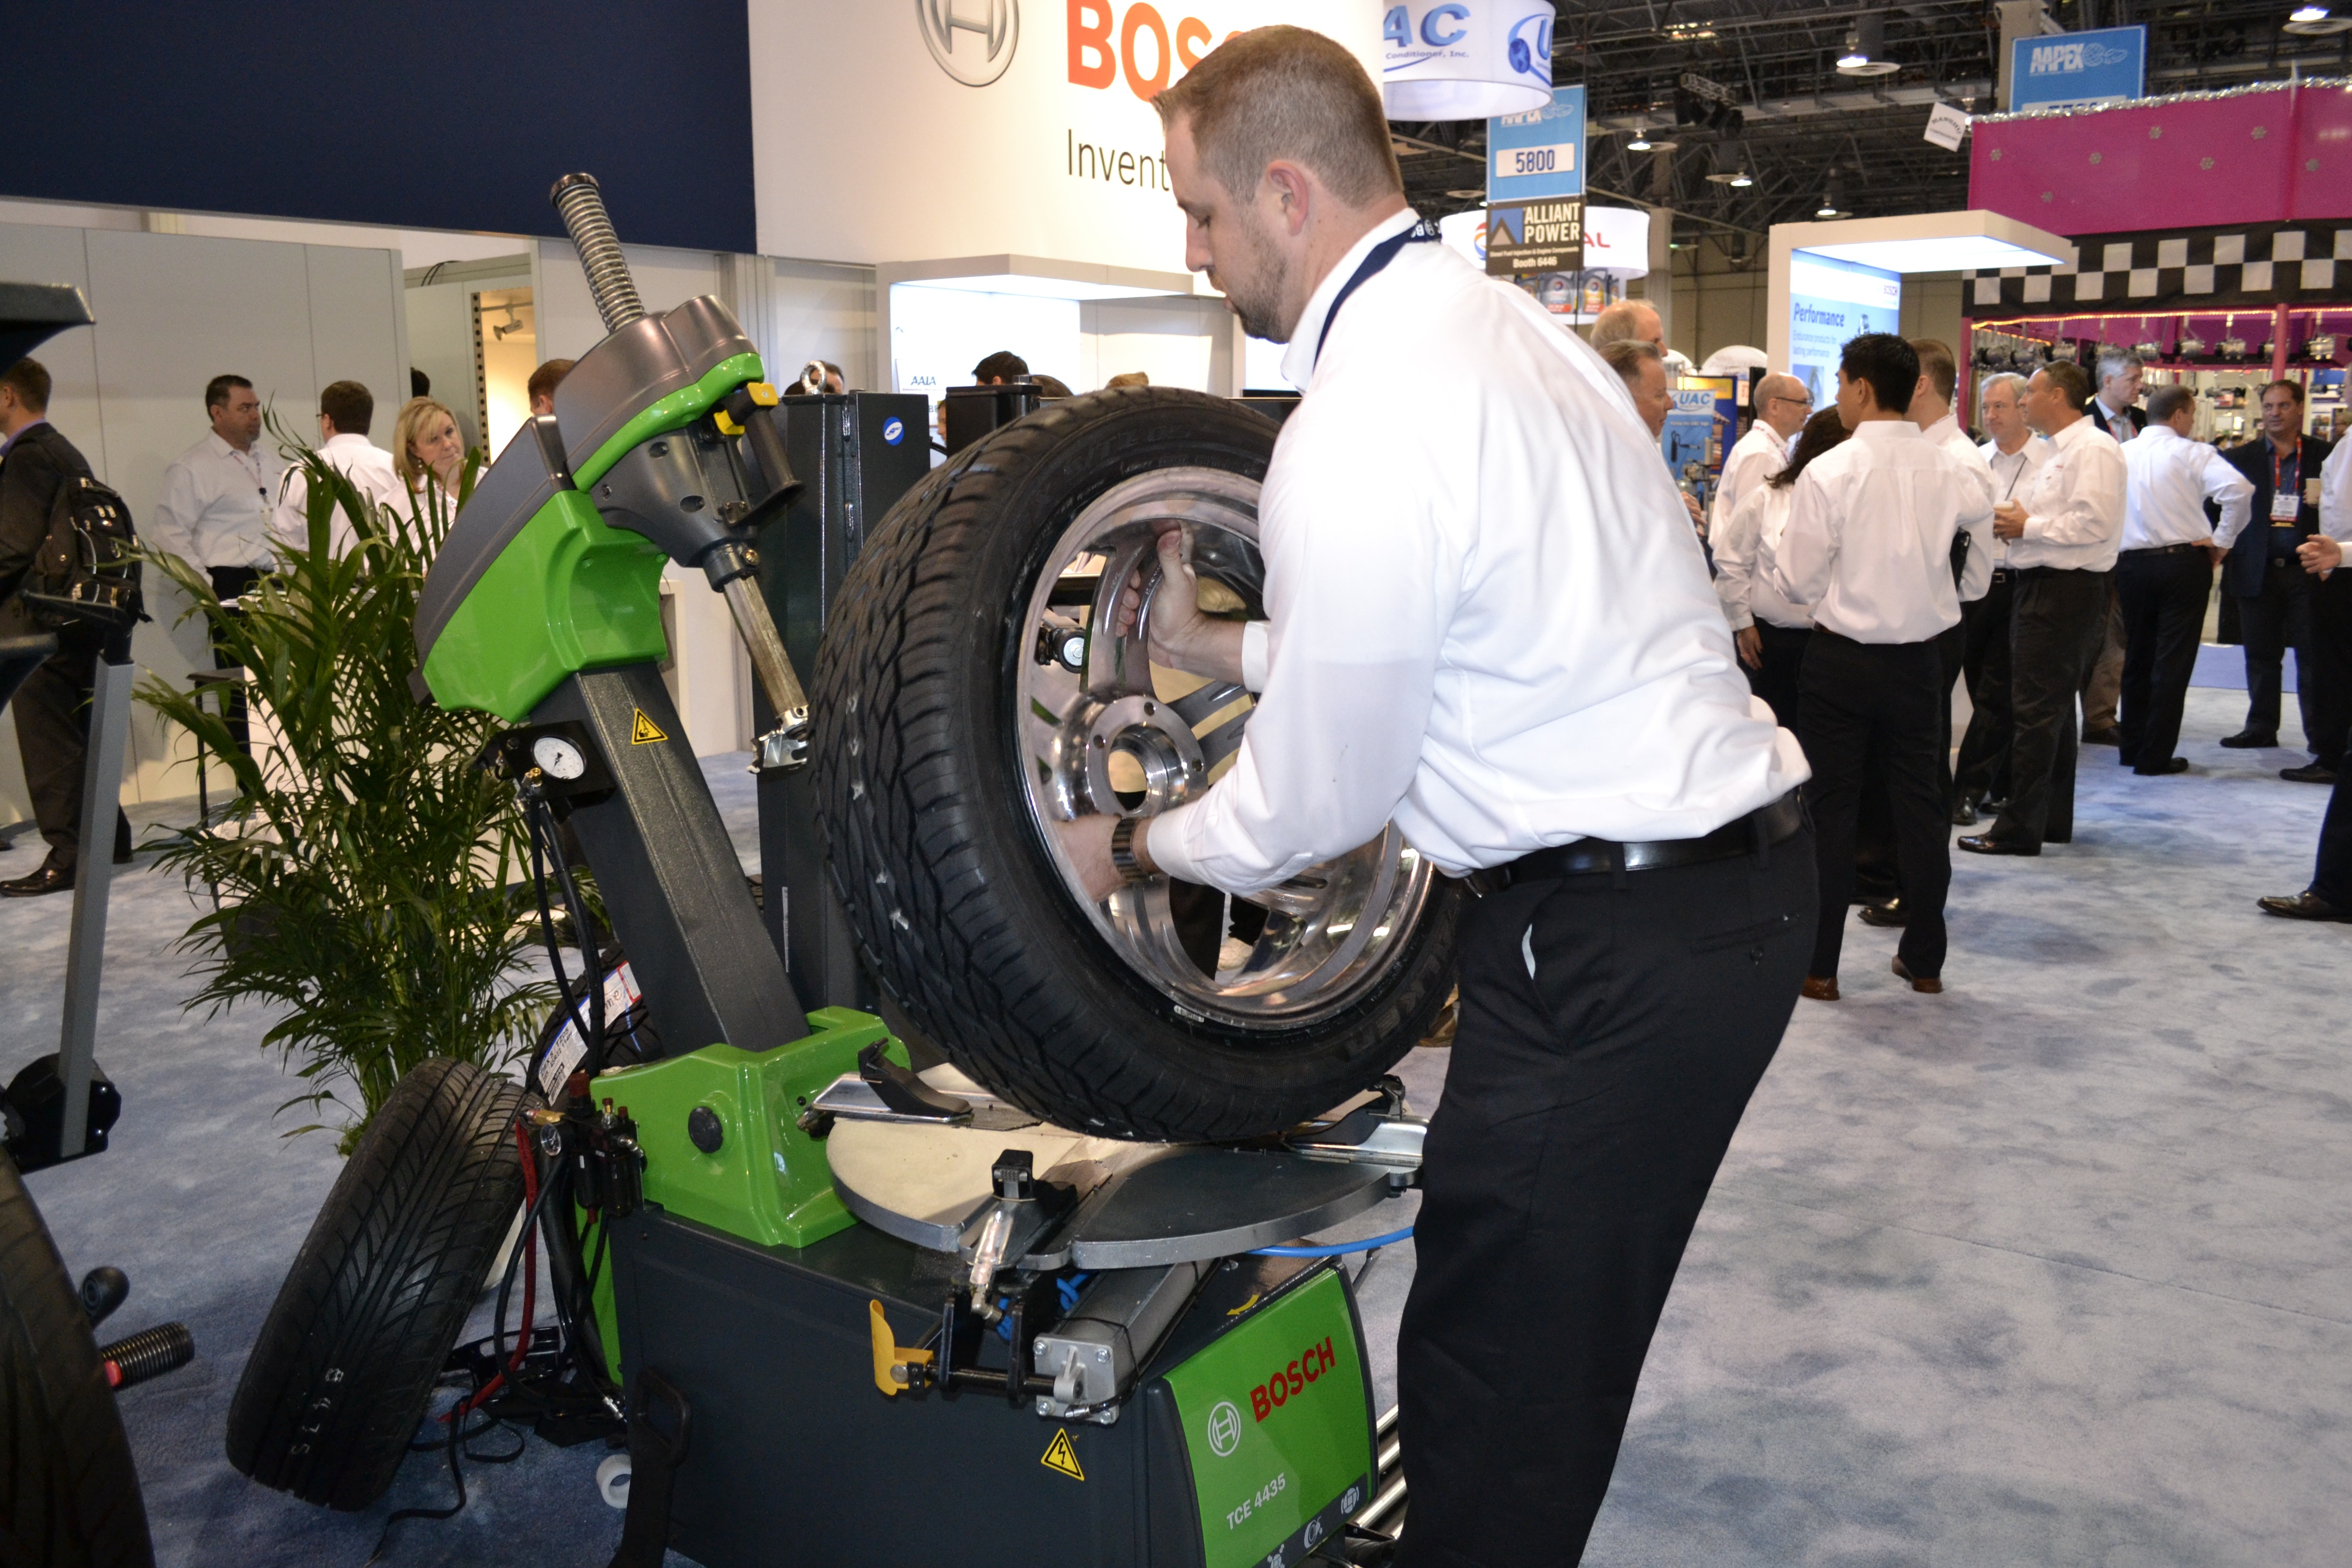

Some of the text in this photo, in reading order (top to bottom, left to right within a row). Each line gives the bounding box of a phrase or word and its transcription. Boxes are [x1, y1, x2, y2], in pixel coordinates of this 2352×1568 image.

[2030, 43, 2085, 74] AAPEX
[1516, 149, 1555, 173] 5800
[1525, 202, 1580, 225] ALLIANT
[1525, 222, 1580, 244] POWER
[1512, 258, 1536, 268] Booth
[1794, 302, 1845, 327] Performance
[911, 376, 936, 385] AAIA
[1679, 393, 1711, 404] UAC
[1250, 1336, 1336, 1424] BOSCH
[1227, 1473, 1286, 1530] TCE 4435
